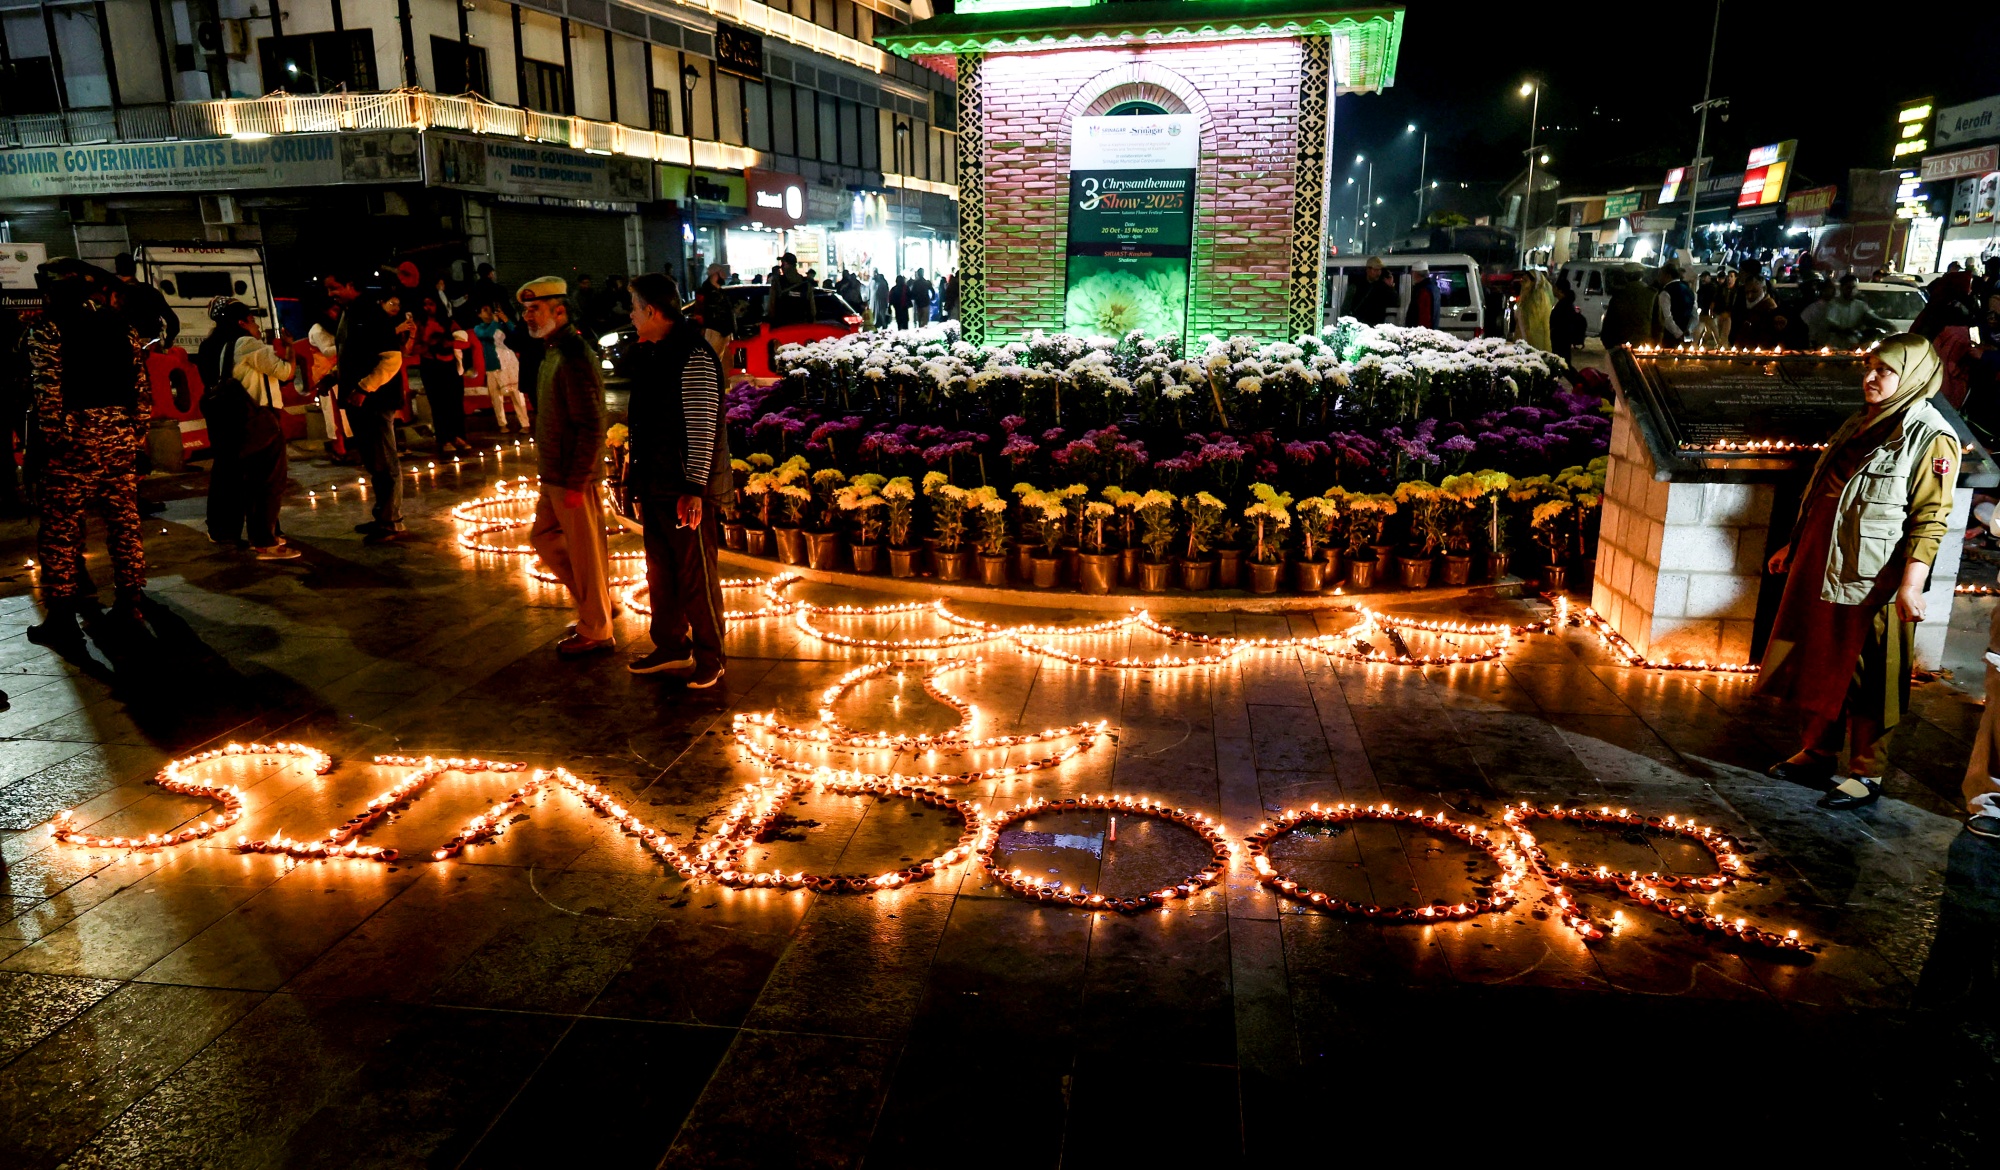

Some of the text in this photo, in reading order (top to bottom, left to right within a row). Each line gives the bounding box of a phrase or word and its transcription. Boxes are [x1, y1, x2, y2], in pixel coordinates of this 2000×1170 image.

[1129, 124, 1164, 137] Srinagar
[1955, 111, 1993, 132] Aerofit
[64, 146, 177, 173] GOVERNMENT
[183, 142, 226, 168] ARTS
[231, 137, 334, 166] EMPORIUM
[487, 144, 606, 169] KASHMIR GOVERNMENT
[1927, 152, 1991, 177] ZEE SPORTS
[510, 163, 593, 183] ARTS EMPORIUM
[1079, 177, 1100, 211] 3
[1102, 177, 1186, 192] Chrysanthemum
[1100, 193, 1185, 209] Show-2025
[194, 247, 226, 255] POLICE
